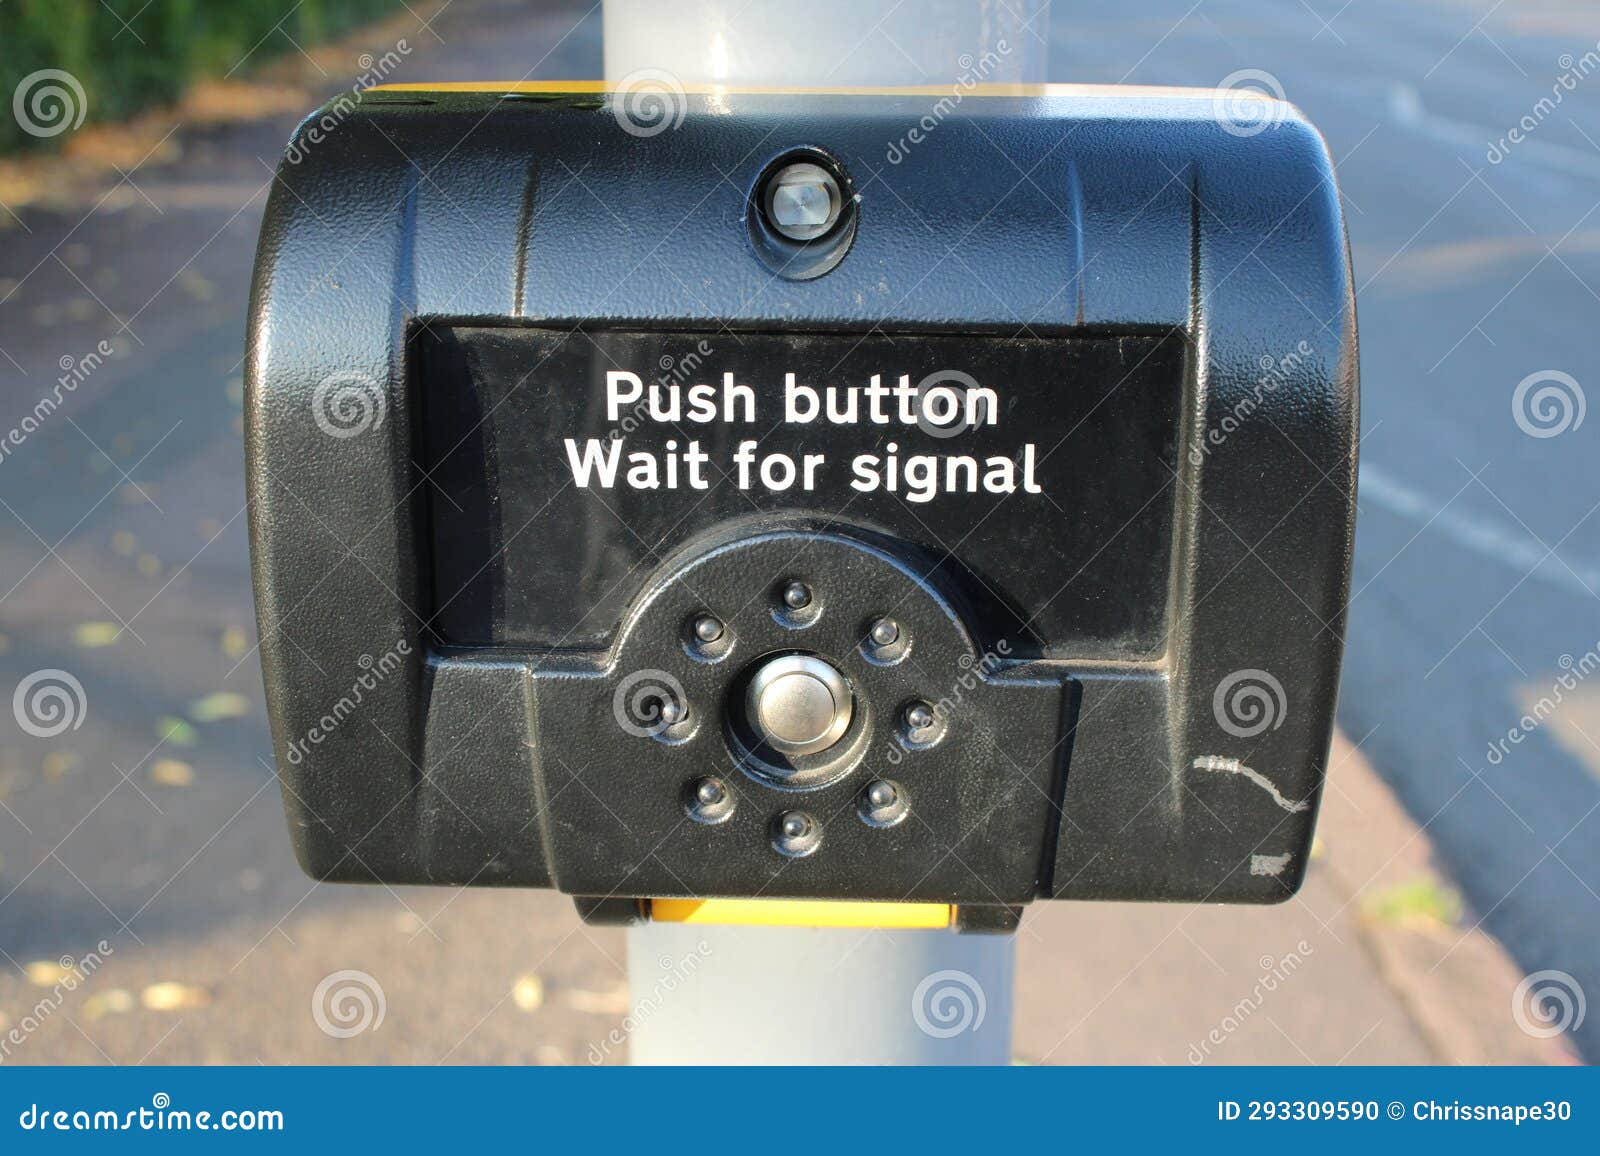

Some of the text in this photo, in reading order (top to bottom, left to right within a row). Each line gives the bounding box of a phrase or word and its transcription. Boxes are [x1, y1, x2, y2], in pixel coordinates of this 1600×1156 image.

[606, 371, 998, 425] Push button
[564, 438, 1042, 503] Wait for signal
